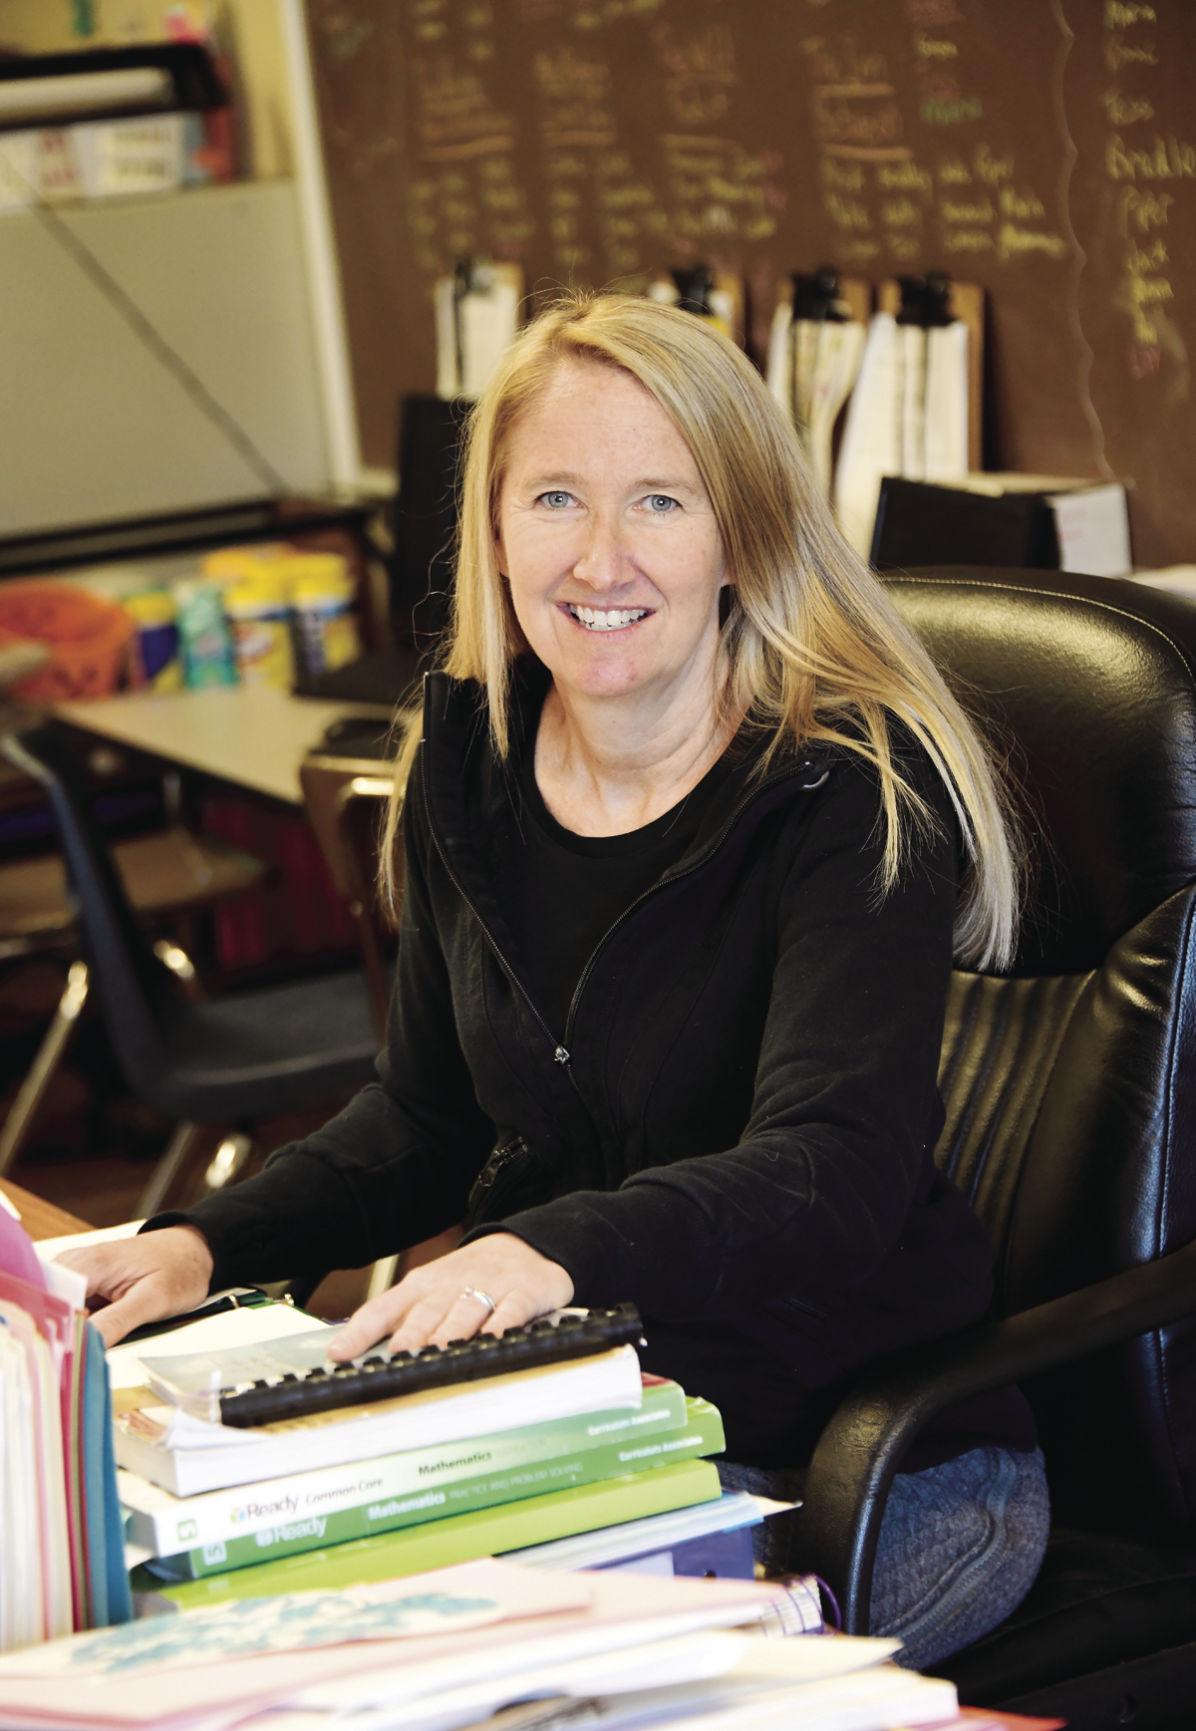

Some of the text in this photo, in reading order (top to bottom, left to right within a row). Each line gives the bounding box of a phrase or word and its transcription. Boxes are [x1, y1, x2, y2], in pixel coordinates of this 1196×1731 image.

[247, 1496, 299, 1519] Ready
[305, 1485, 357, 1506] Common
[358, 1476, 384, 1493] Core
[418, 1451, 493, 1476] Mathematics
[273, 1516, 328, 1544] Ready
[368, 1492, 447, 1520] Mathematics
